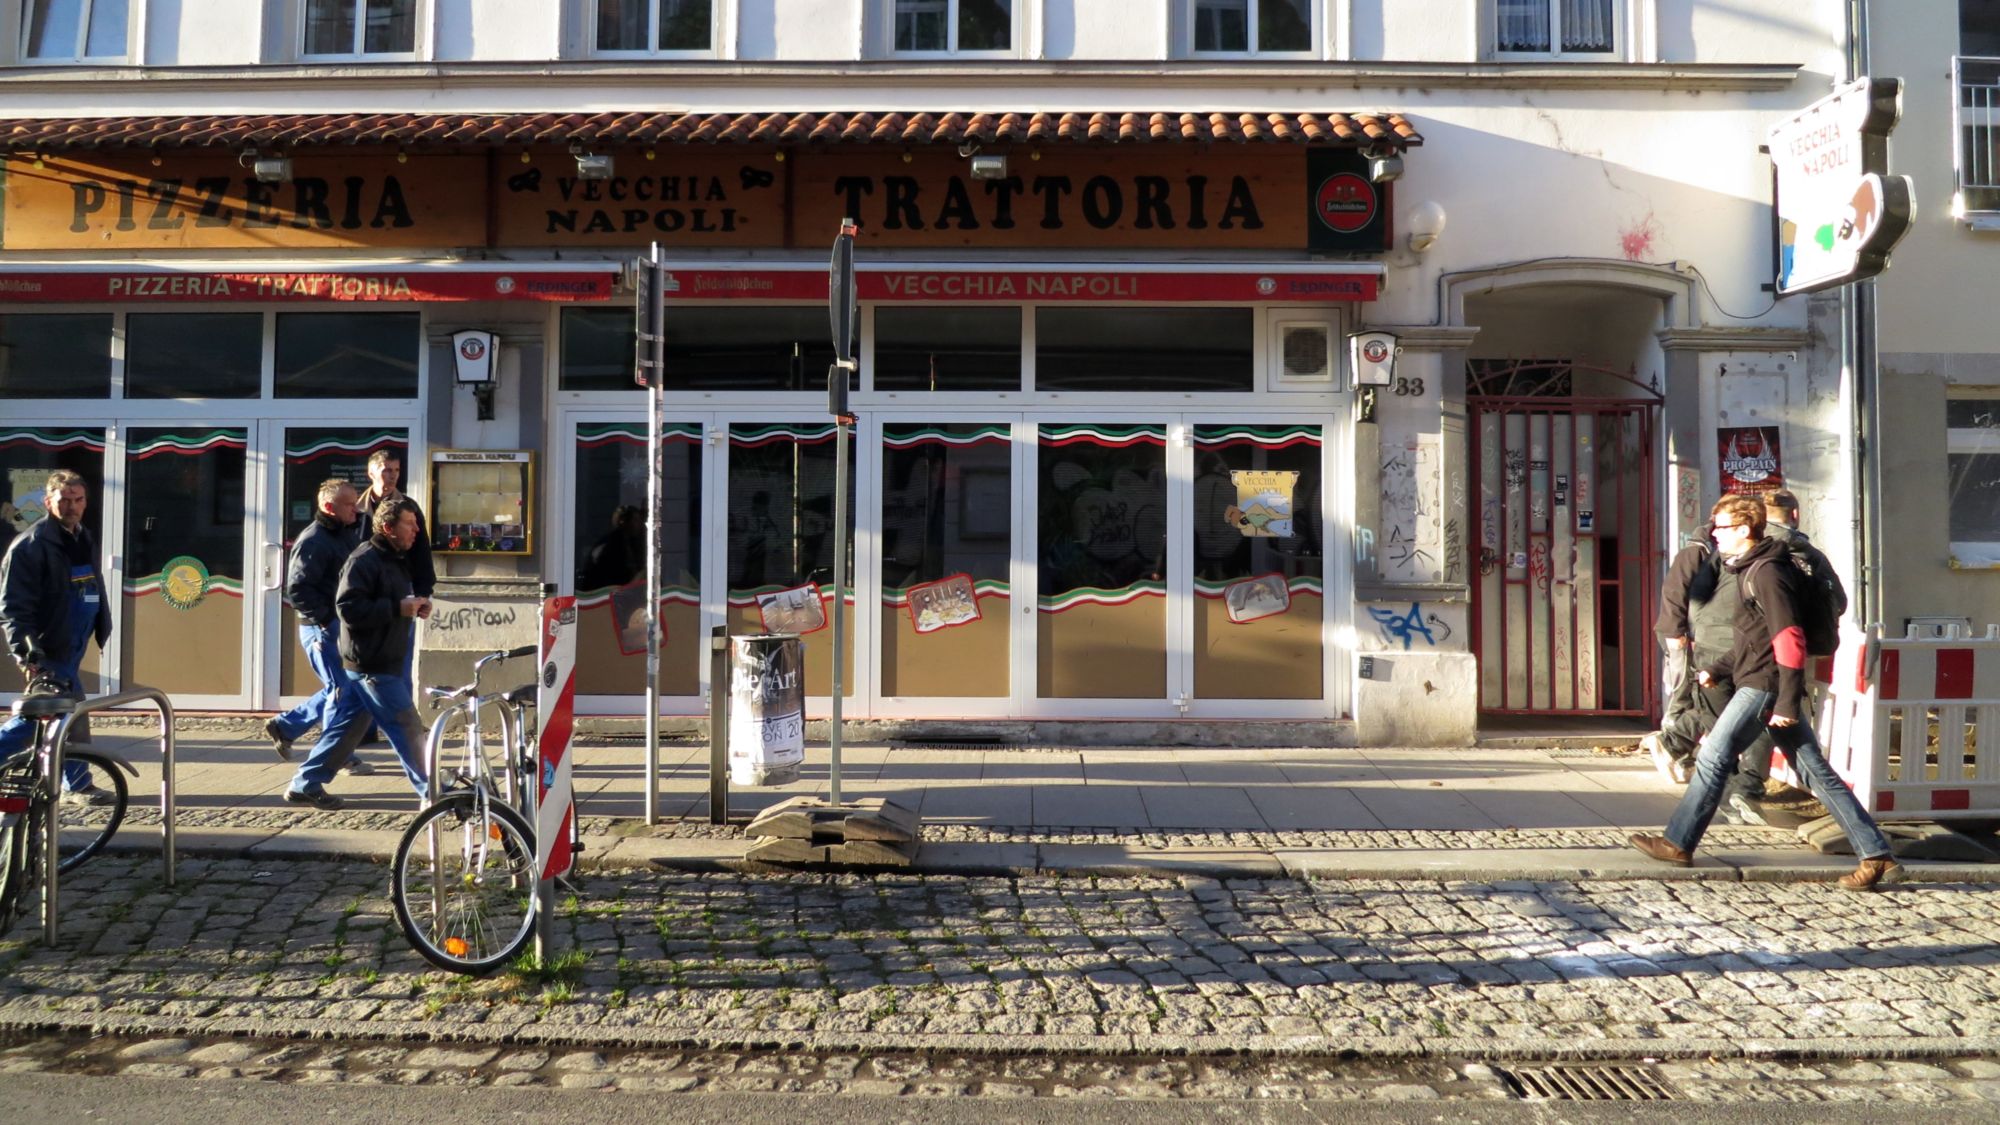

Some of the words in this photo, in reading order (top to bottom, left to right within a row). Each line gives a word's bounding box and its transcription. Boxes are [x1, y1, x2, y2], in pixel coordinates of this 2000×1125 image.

[1789, 122, 1841, 157] VECCHIA
[1803, 145, 1850, 176] NAPOLI
[557, 176, 728, 201] VECCHIA
[68, 175, 415, 233] PIZZERIA
[833, 174, 1265, 231] TRATTORIA
[545, 208, 738, 233] NAPOLI
[108, 276, 231, 296] PIZZERIA
[255, 276, 412, 296] TRATTORIA
[527, 280, 598, 294] ERDINGER
[883, 273, 1017, 296] VECCHIA
[1025, 275, 1139, 297] NAPOLI
[1289, 280, 1362, 294] ERDINGER
[1395, 376, 1425, 397] 33
[1723, 459, 1777, 472] PRO-PAIN
[1243, 477, 1278, 486] VECCHIA
[769, 667, 797, 691] Art
[787, 721, 800, 738] 20
